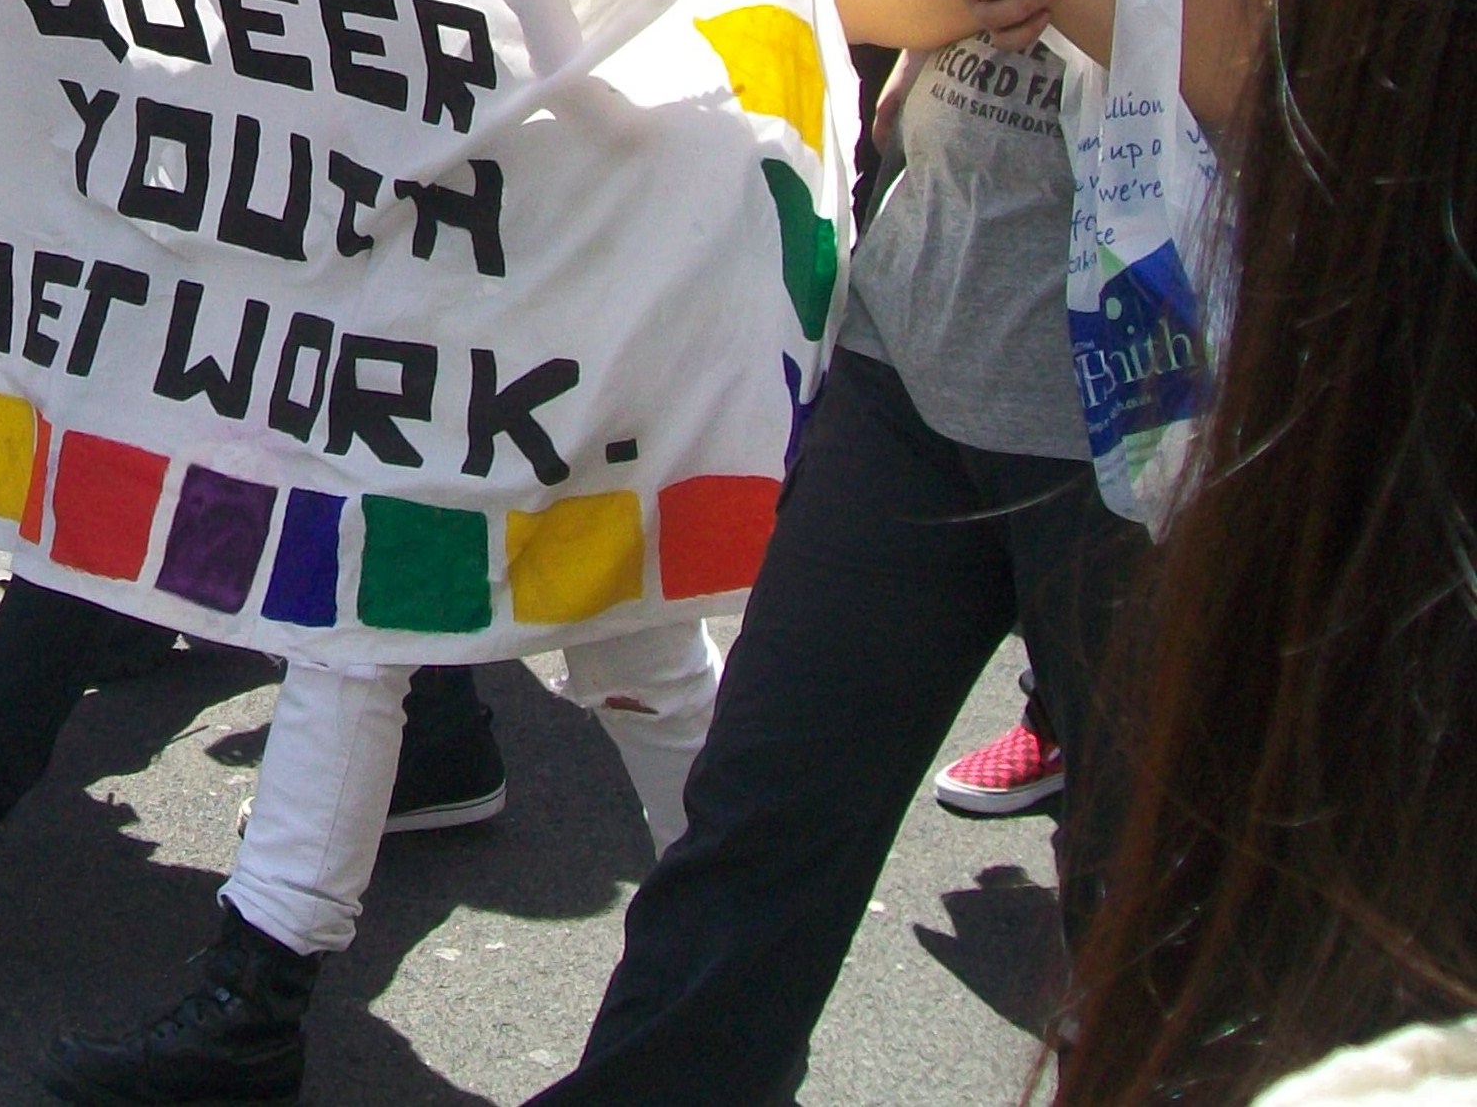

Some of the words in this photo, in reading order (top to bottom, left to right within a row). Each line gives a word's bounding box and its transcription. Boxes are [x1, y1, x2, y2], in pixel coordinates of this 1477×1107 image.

[929, 82, 946, 101] ALL
[947, 88, 969, 110] DAY
[58, 78, 506, 277] YOUTH
